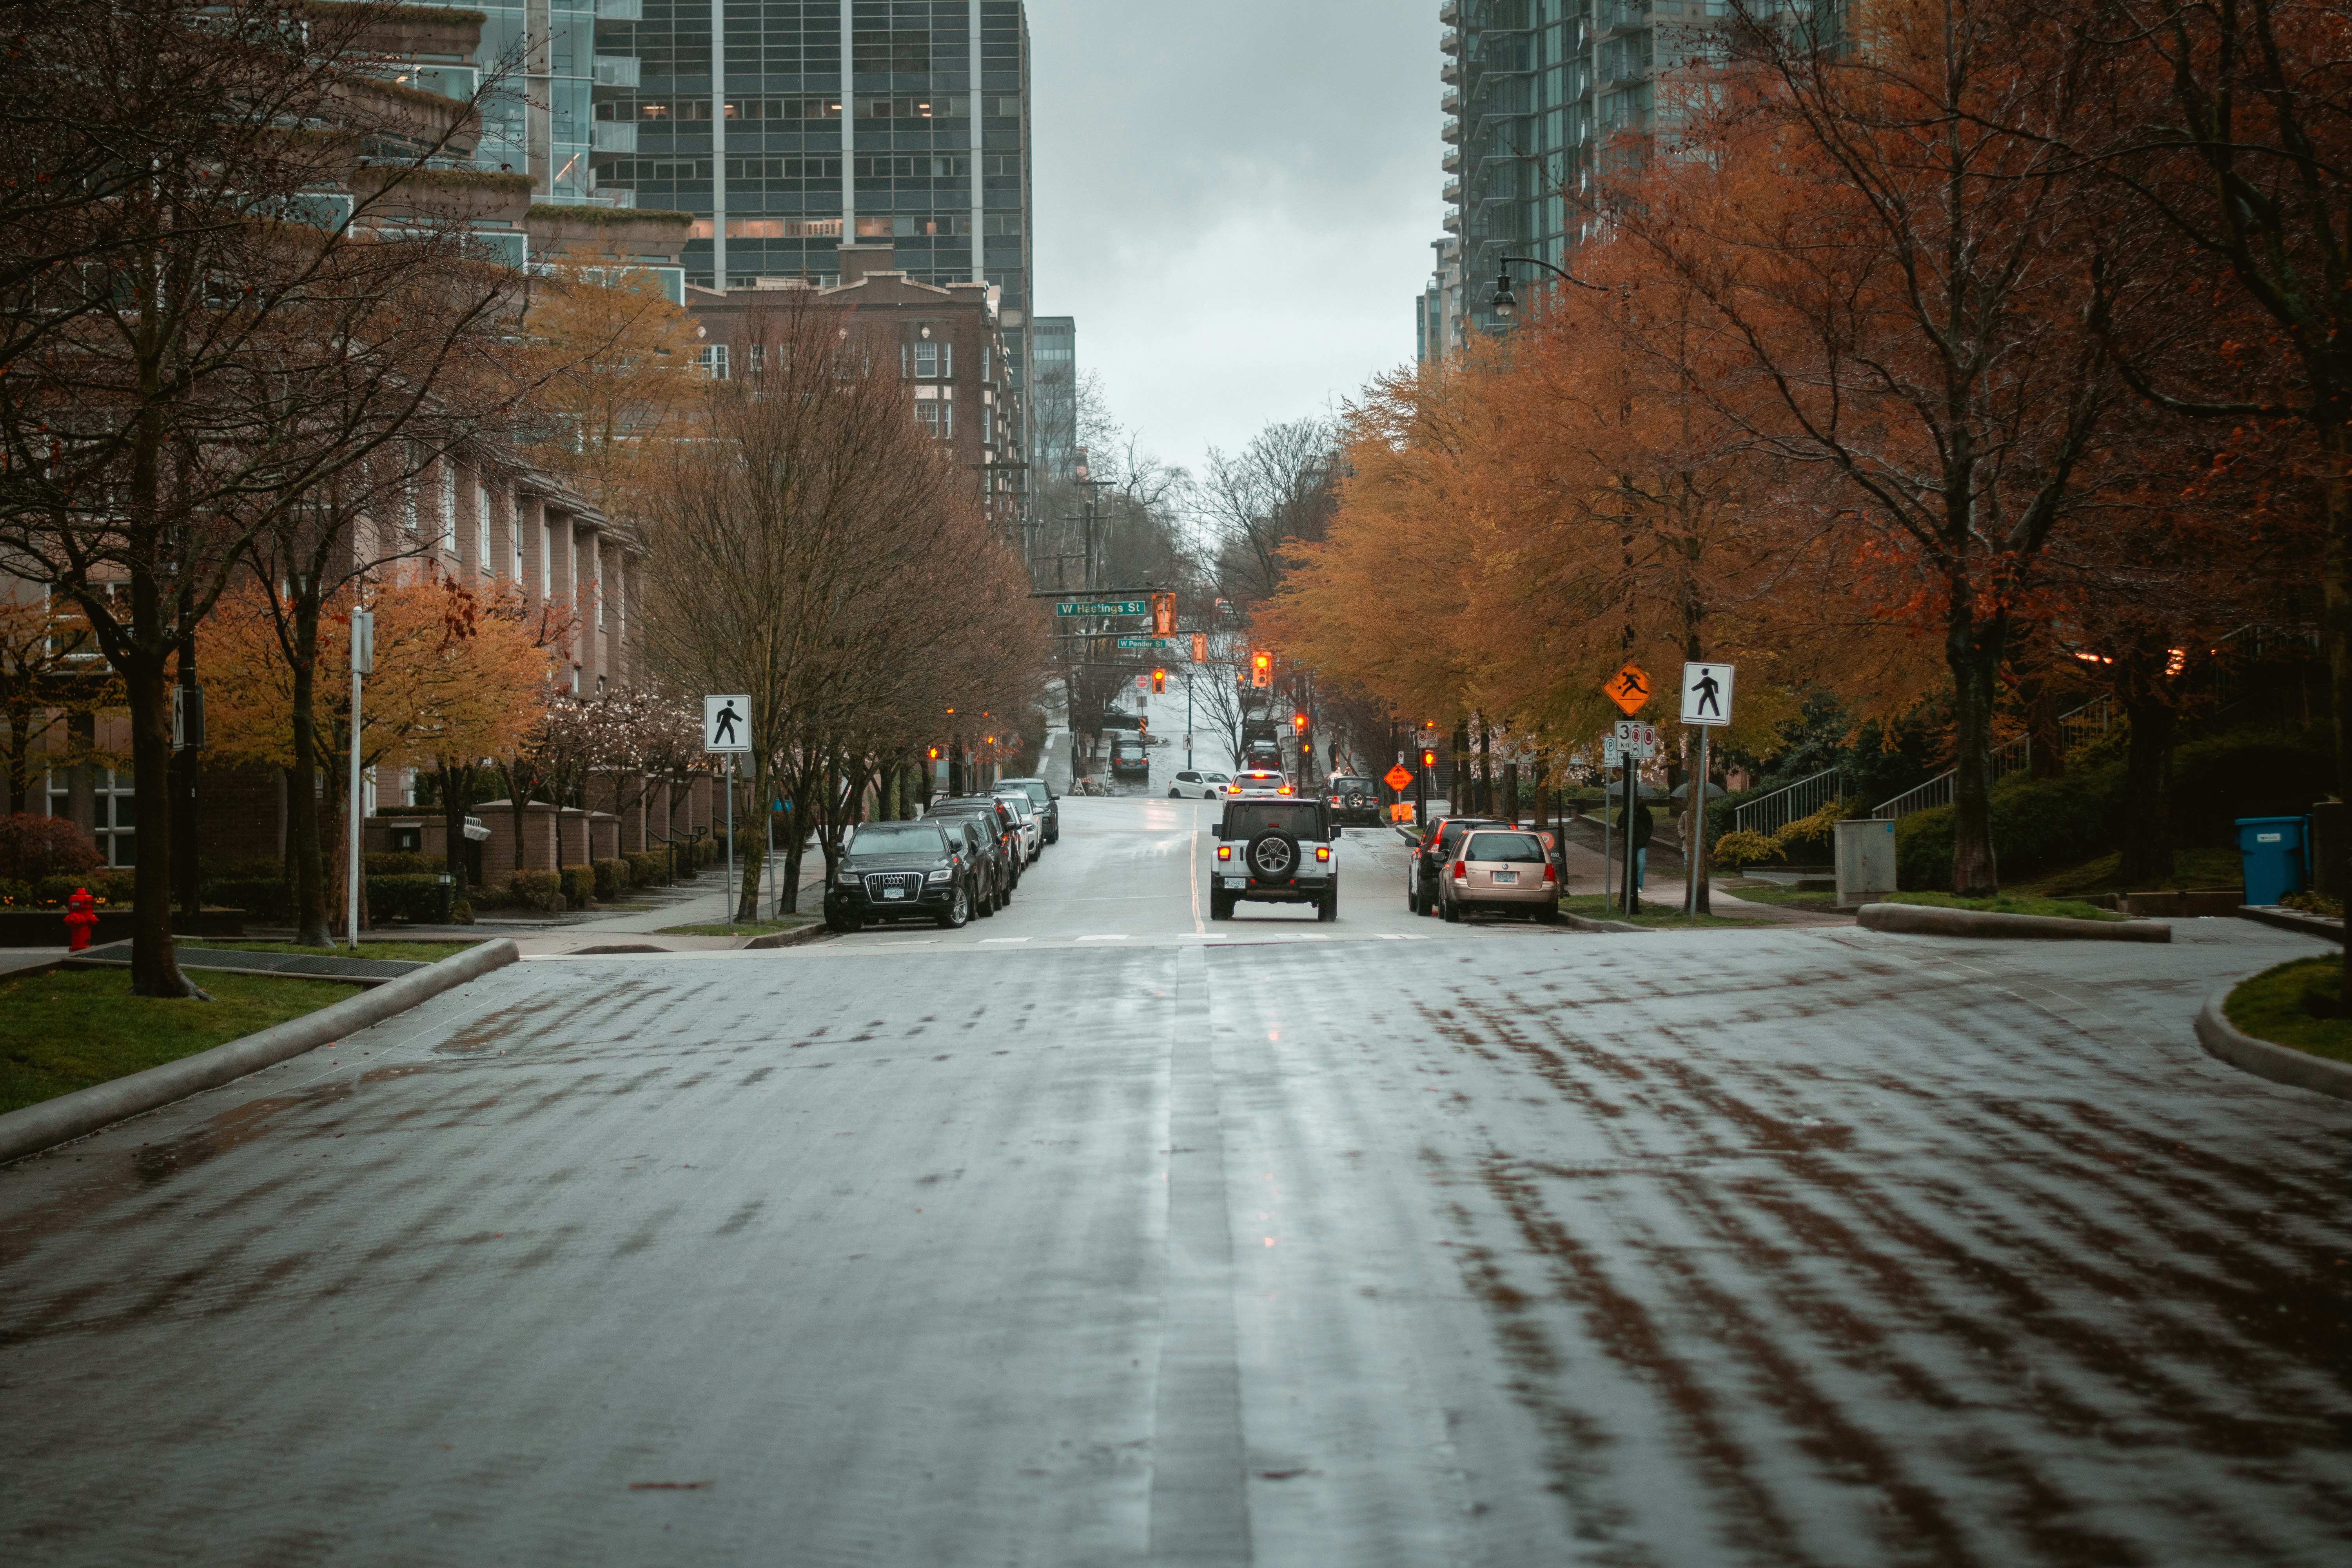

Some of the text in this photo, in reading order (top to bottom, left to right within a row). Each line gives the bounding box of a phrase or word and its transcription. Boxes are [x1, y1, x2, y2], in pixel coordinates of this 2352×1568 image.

[1062, 603, 1140, 614] W Hastings St
